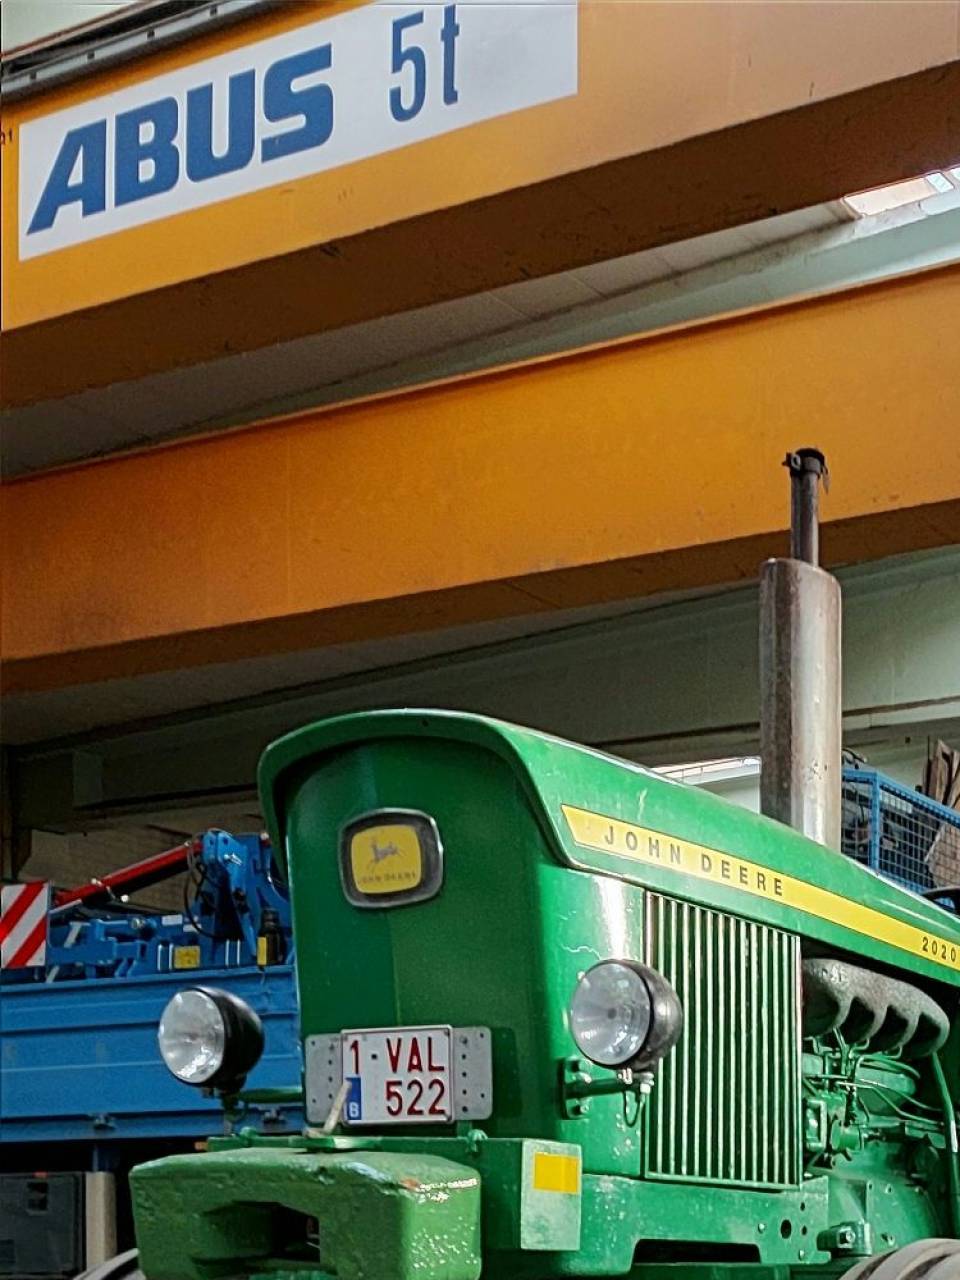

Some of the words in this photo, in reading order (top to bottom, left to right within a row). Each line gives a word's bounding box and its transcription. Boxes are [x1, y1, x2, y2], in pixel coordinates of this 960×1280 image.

[26, 43, 334, 236] ABUS
[389, 11, 427, 122] 5
[441, 3, 460, 105] t
[604, 825, 681, 865] JOHN
[701, 853, 783, 896] DEERE
[922, 936, 957, 962] 2020
[348, 1101, 360, 1119] B
[386, 1078, 447, 1117] 522
